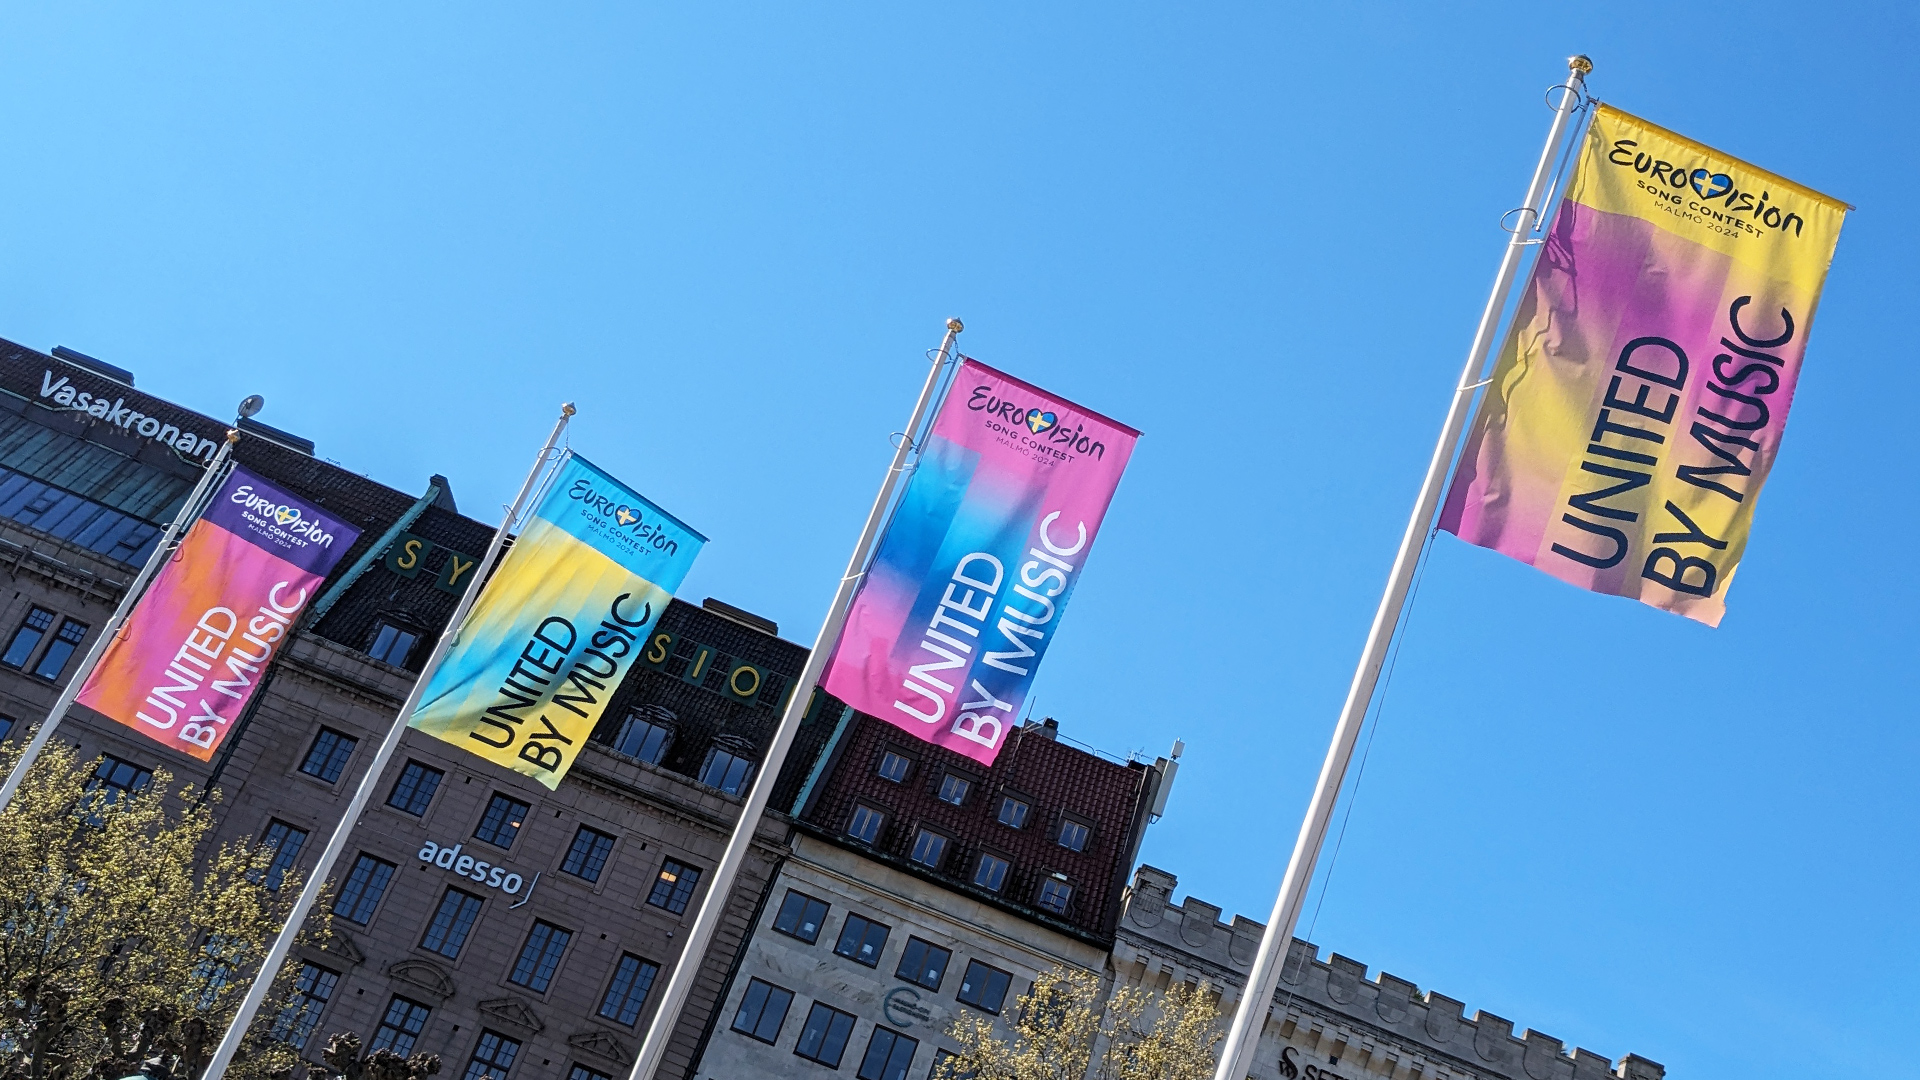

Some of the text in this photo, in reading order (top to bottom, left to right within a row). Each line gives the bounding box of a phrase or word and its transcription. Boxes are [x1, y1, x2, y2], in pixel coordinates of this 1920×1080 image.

[1636, 179, 1764, 238] SONG CONTEST
[1654, 200, 1739, 239] MALMÖ 2024
[39, 370, 218, 460] Vasakronan
[985, 420, 1075, 463] SONG CONTEST
[996, 436, 1055, 467] MALMÖ 2024
[1641, 295, 1795, 598] BY MUSIC
[1551, 335, 1690, 570] UNITED
[241, 510, 309, 548] SONG CONTEST
[274, 537, 292, 550] 2024
[580, 509, 651, 556] SONG CONTEST
[587, 524, 635, 557] MALMÖ 2024
[177, 580, 307, 751] BY MUSIC
[893, 552, 1004, 724] UNITED
[950, 510, 1087, 750] BY MUSIC
[135, 606, 238, 730] UNITED
[468, 615, 577, 749] UNITED
[518, 592, 652, 774] BY MUSIC
[418, 840, 523, 895] adesso
